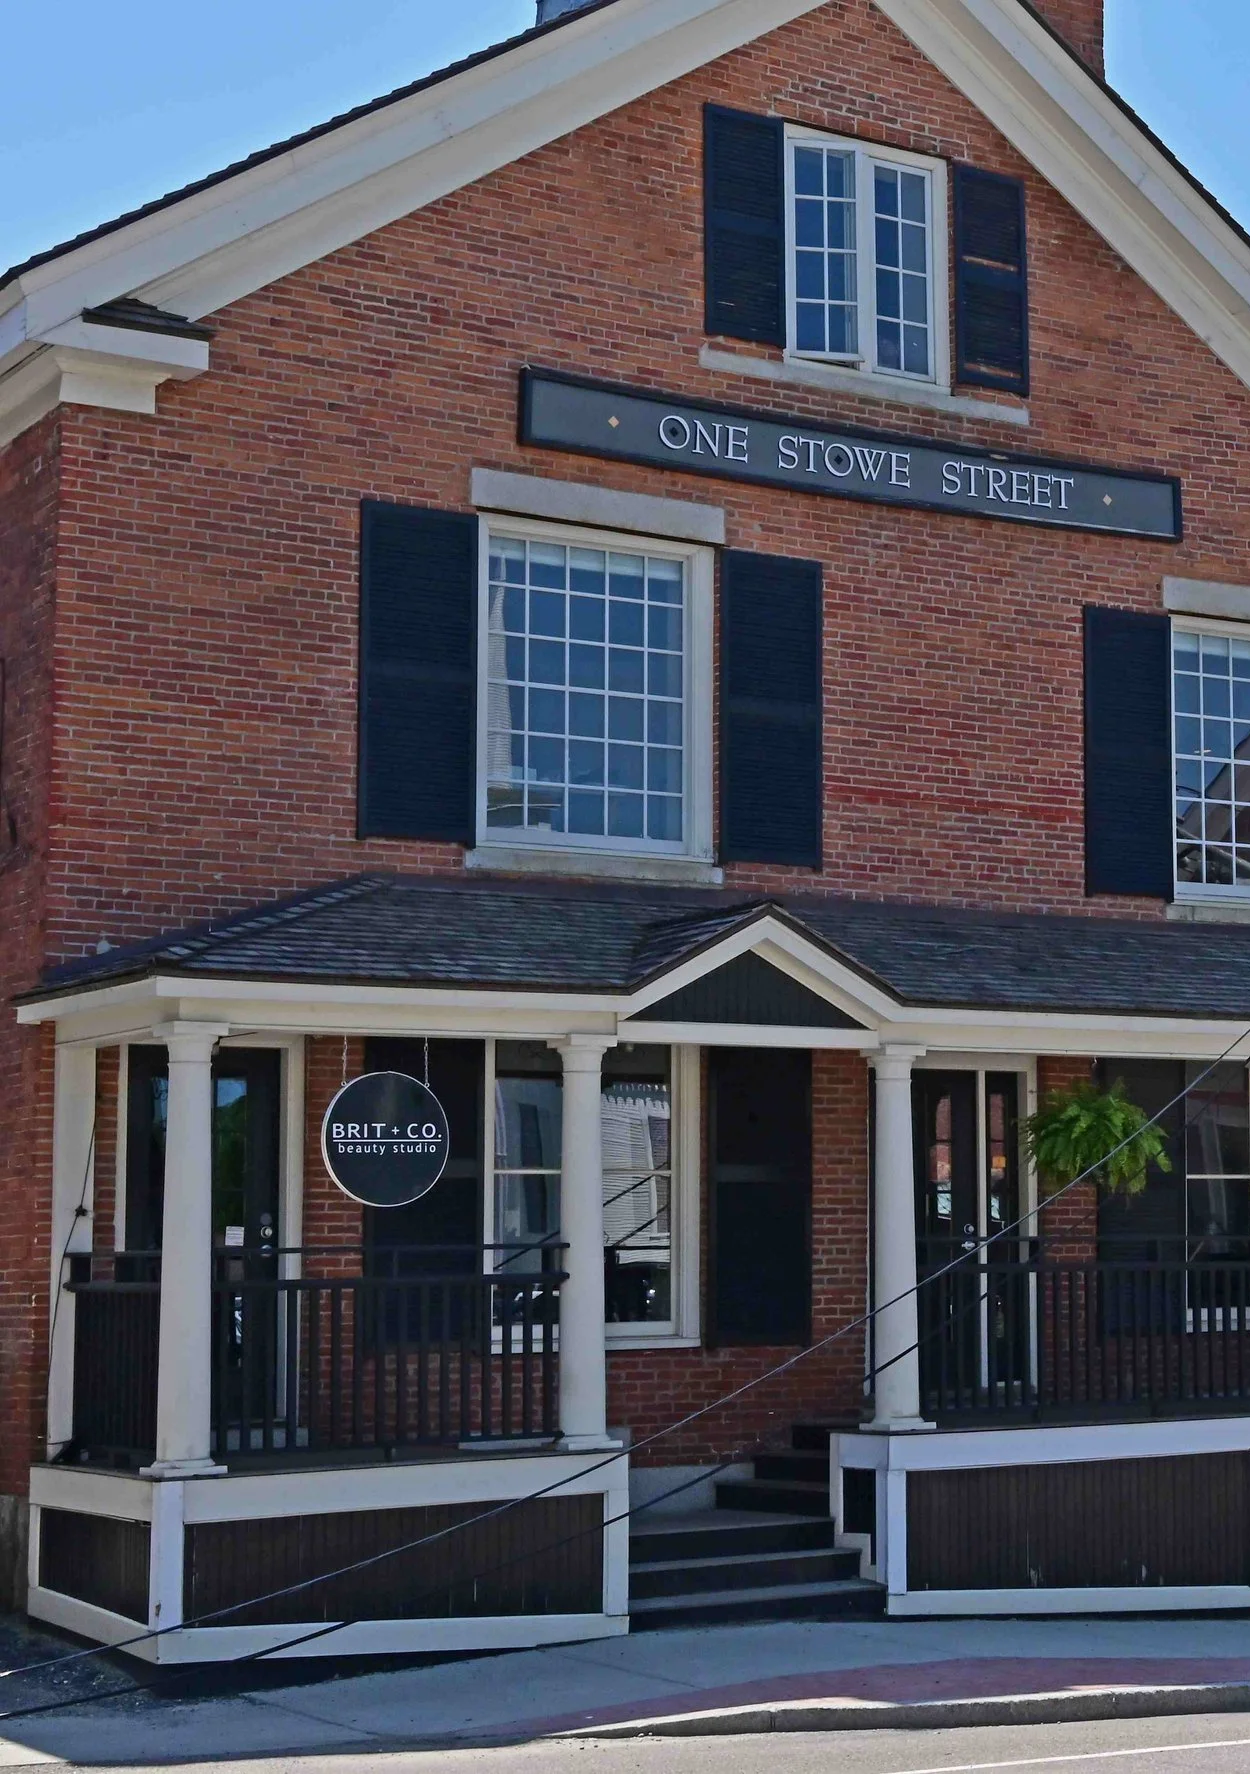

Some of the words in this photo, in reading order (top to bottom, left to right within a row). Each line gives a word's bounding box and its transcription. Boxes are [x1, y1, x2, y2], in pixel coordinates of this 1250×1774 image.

[658, 415, 750, 464] ONE
[778, 435, 911, 489] STOWE
[942, 461, 1074, 510] STREET
[332, 1123, 387, 1138] BRIT
[406, 1123, 442, 1139] CO.
[338, 1142, 386, 1156] beauty
[393, 1142, 436, 1153] studio
